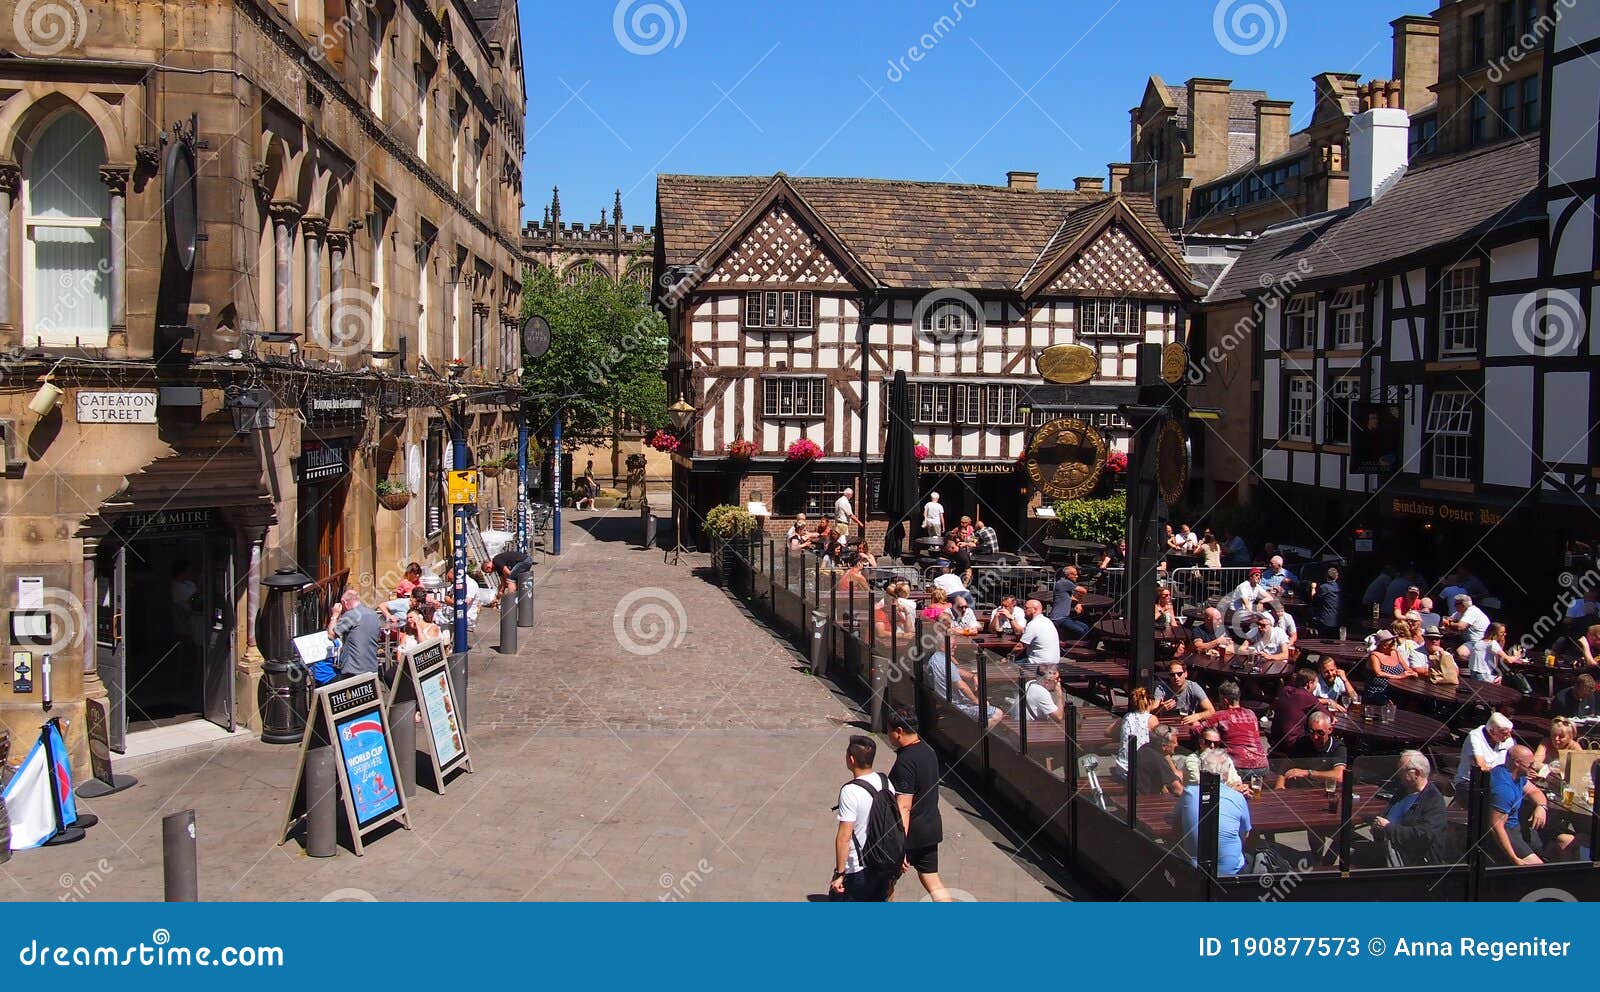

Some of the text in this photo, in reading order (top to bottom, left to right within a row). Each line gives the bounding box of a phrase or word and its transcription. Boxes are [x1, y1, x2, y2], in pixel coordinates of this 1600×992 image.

[80, 395, 155, 406] CATEATON
[92, 408, 142, 420] STREET
[934, 464, 956, 472] OLD
[1392, 499, 1502, 525] Sinclairs Oyster Bar
[331, 684, 374, 706] THE MITRE
[347, 746, 384, 767] WORLD CUP
